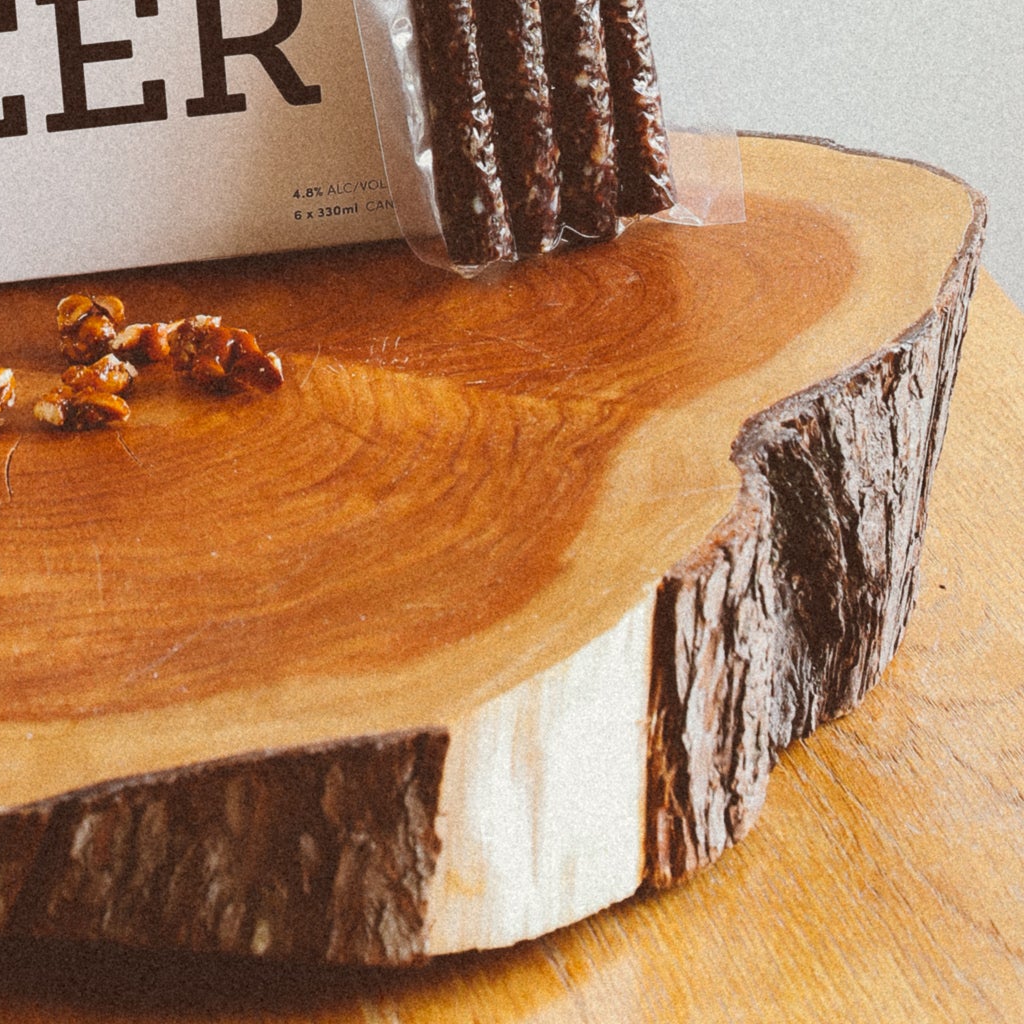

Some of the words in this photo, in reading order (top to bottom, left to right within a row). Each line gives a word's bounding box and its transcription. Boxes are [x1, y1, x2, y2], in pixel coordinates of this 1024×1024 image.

[292, 186, 324, 200] 4.8%
[326, 179, 388, 196] ALC/VOL
[294, 210, 302, 220] 6
[306, 212, 314, 220] x
[317, 203, 358, 218] 330ml
